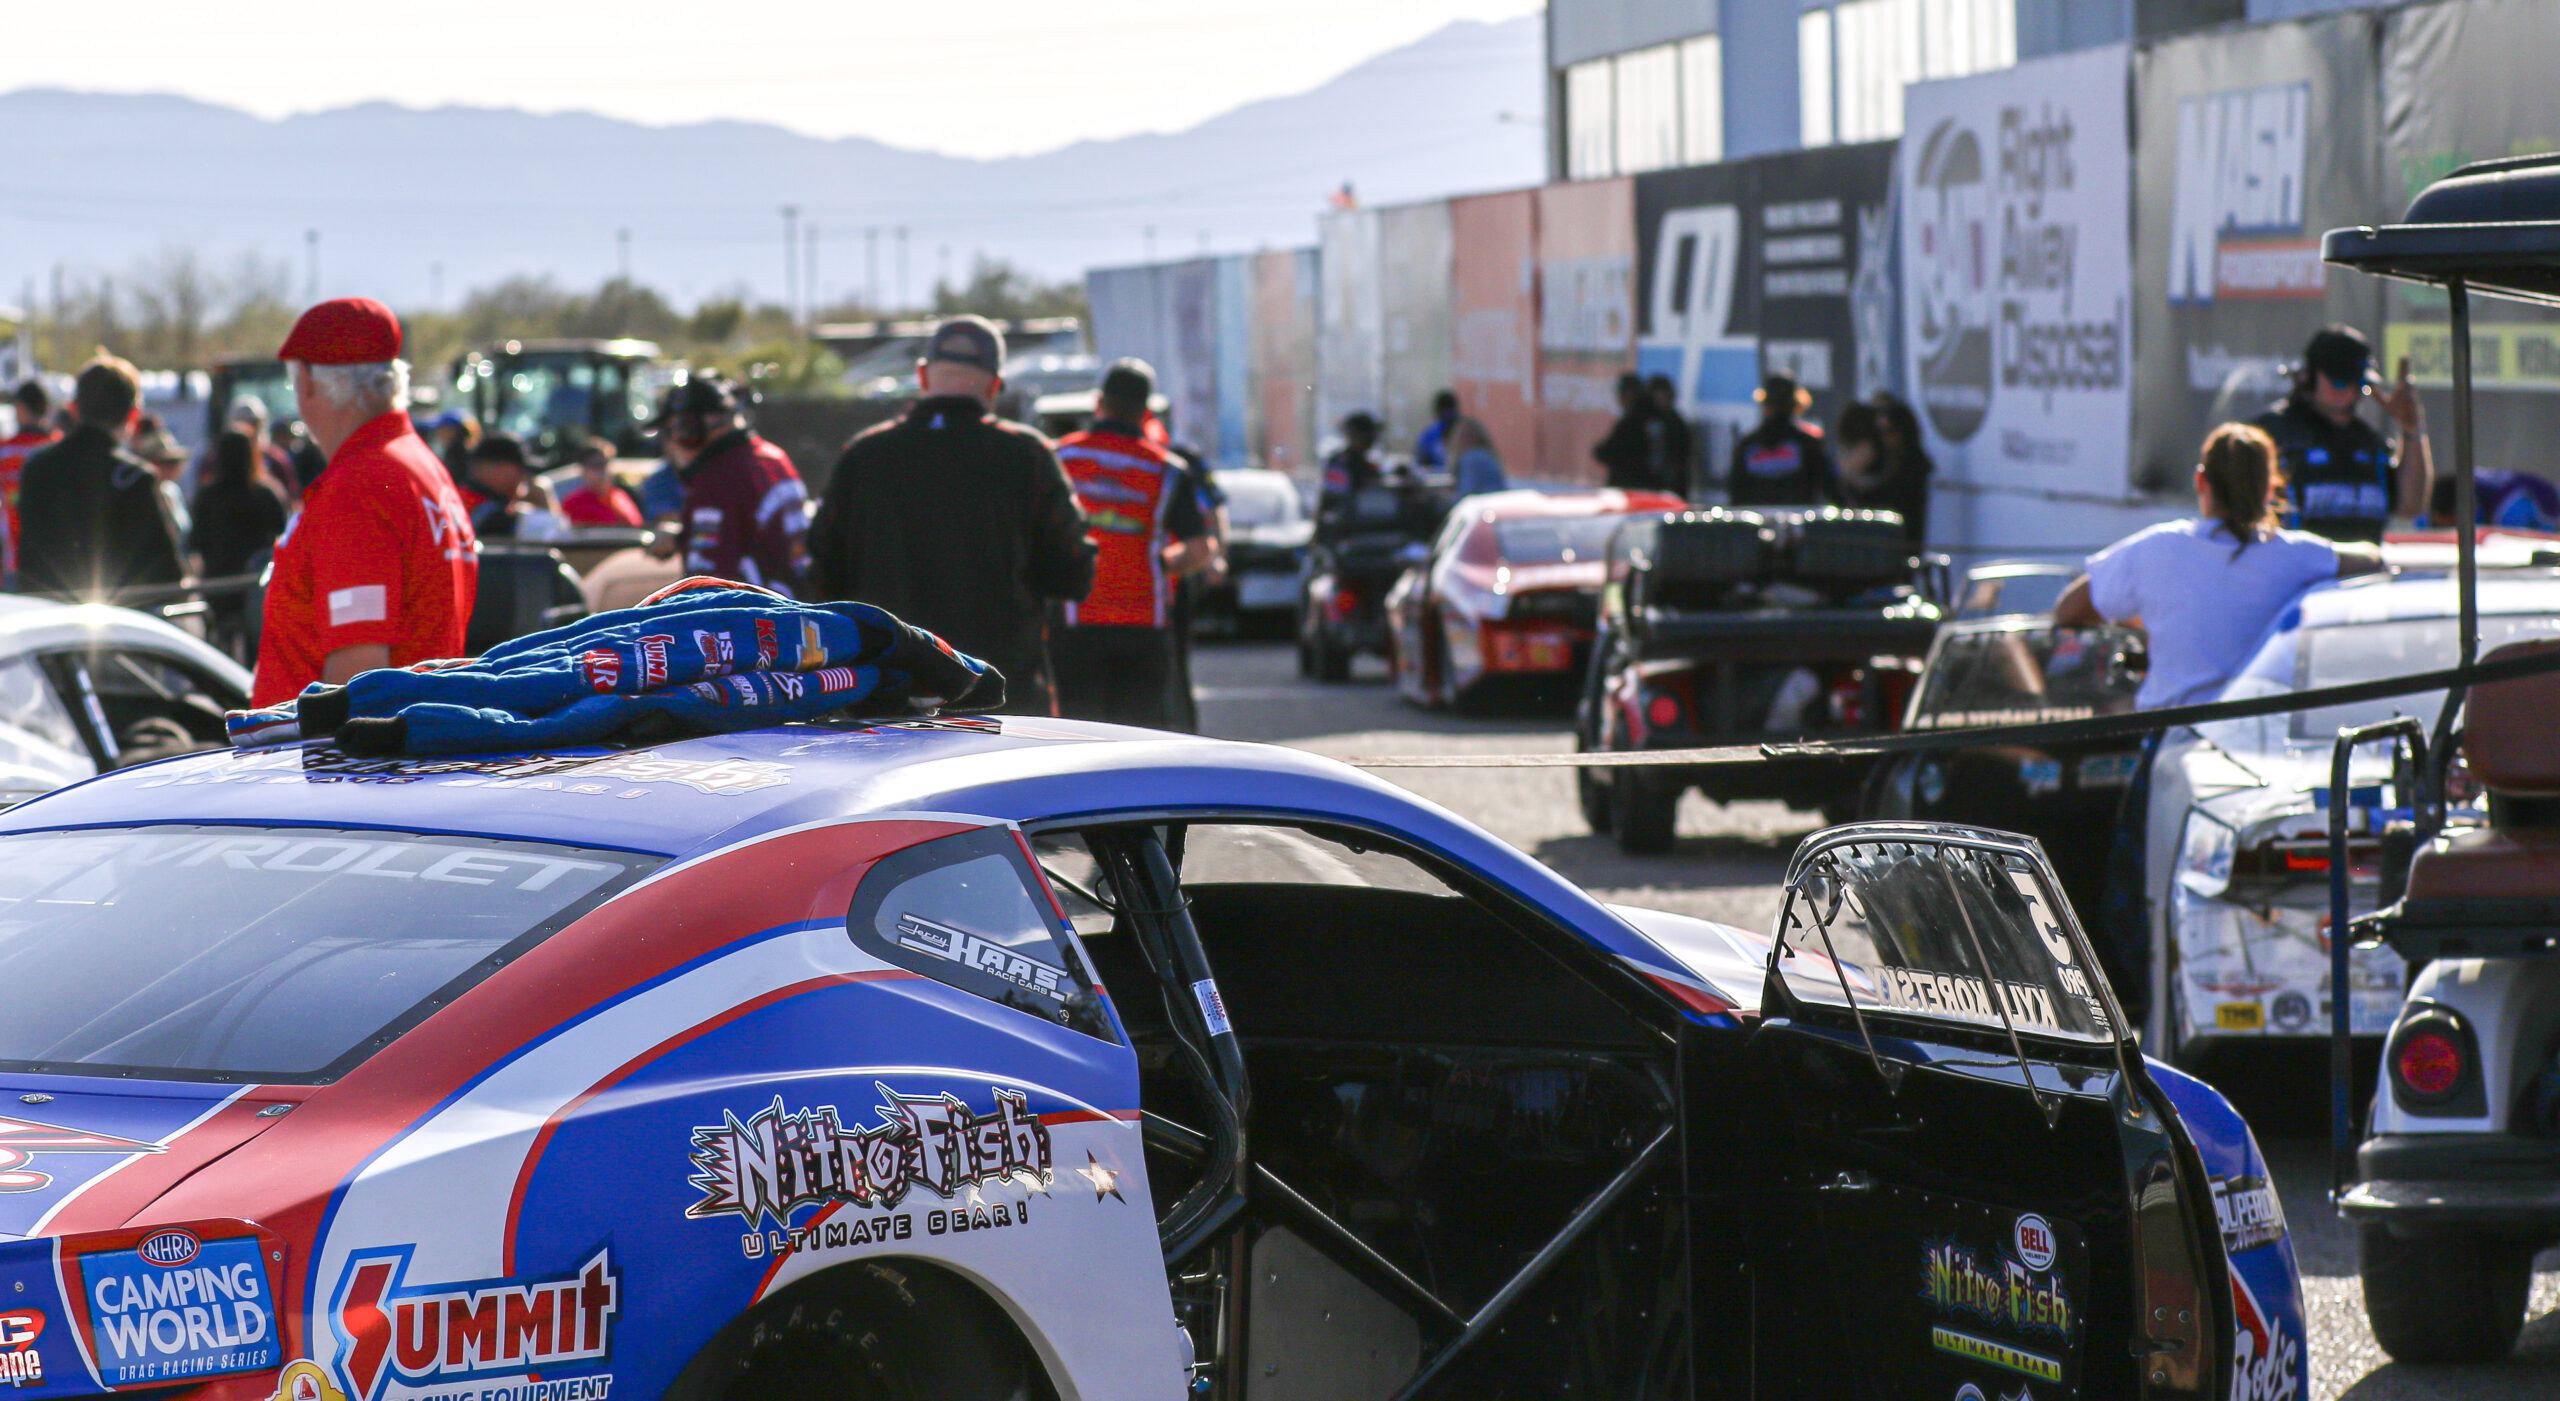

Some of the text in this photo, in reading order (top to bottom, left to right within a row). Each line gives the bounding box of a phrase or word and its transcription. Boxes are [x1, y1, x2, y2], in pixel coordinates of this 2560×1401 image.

[2000, 102, 2074, 220] Right
[2168, 84, 2306, 300] NASH
[2000, 202, 2077, 316] Away
[2001, 297, 2123, 414] Disposal
[898, 924, 950, 948] Jerry
[948, 930, 1059, 990] HAAS
[986, 967, 1048, 995] RACE CARS
[698, 1088, 1048, 1220] Nitro Fish
[147, 1236, 197, 1261] NHRA
[741, 1201, 1029, 1259] ULTIMATE GEAR!
[2020, 1226, 2051, 1254] BELL
[94, 1262, 260, 1314] CAMPING
[1928, 1244, 2067, 1335] Nitro Fish
[101, 1300, 267, 1359] WORLD
[1935, 1330, 2006, 1363] ULTIMATE
[119, 1349, 268, 1381] DRAG RACING SERIES
